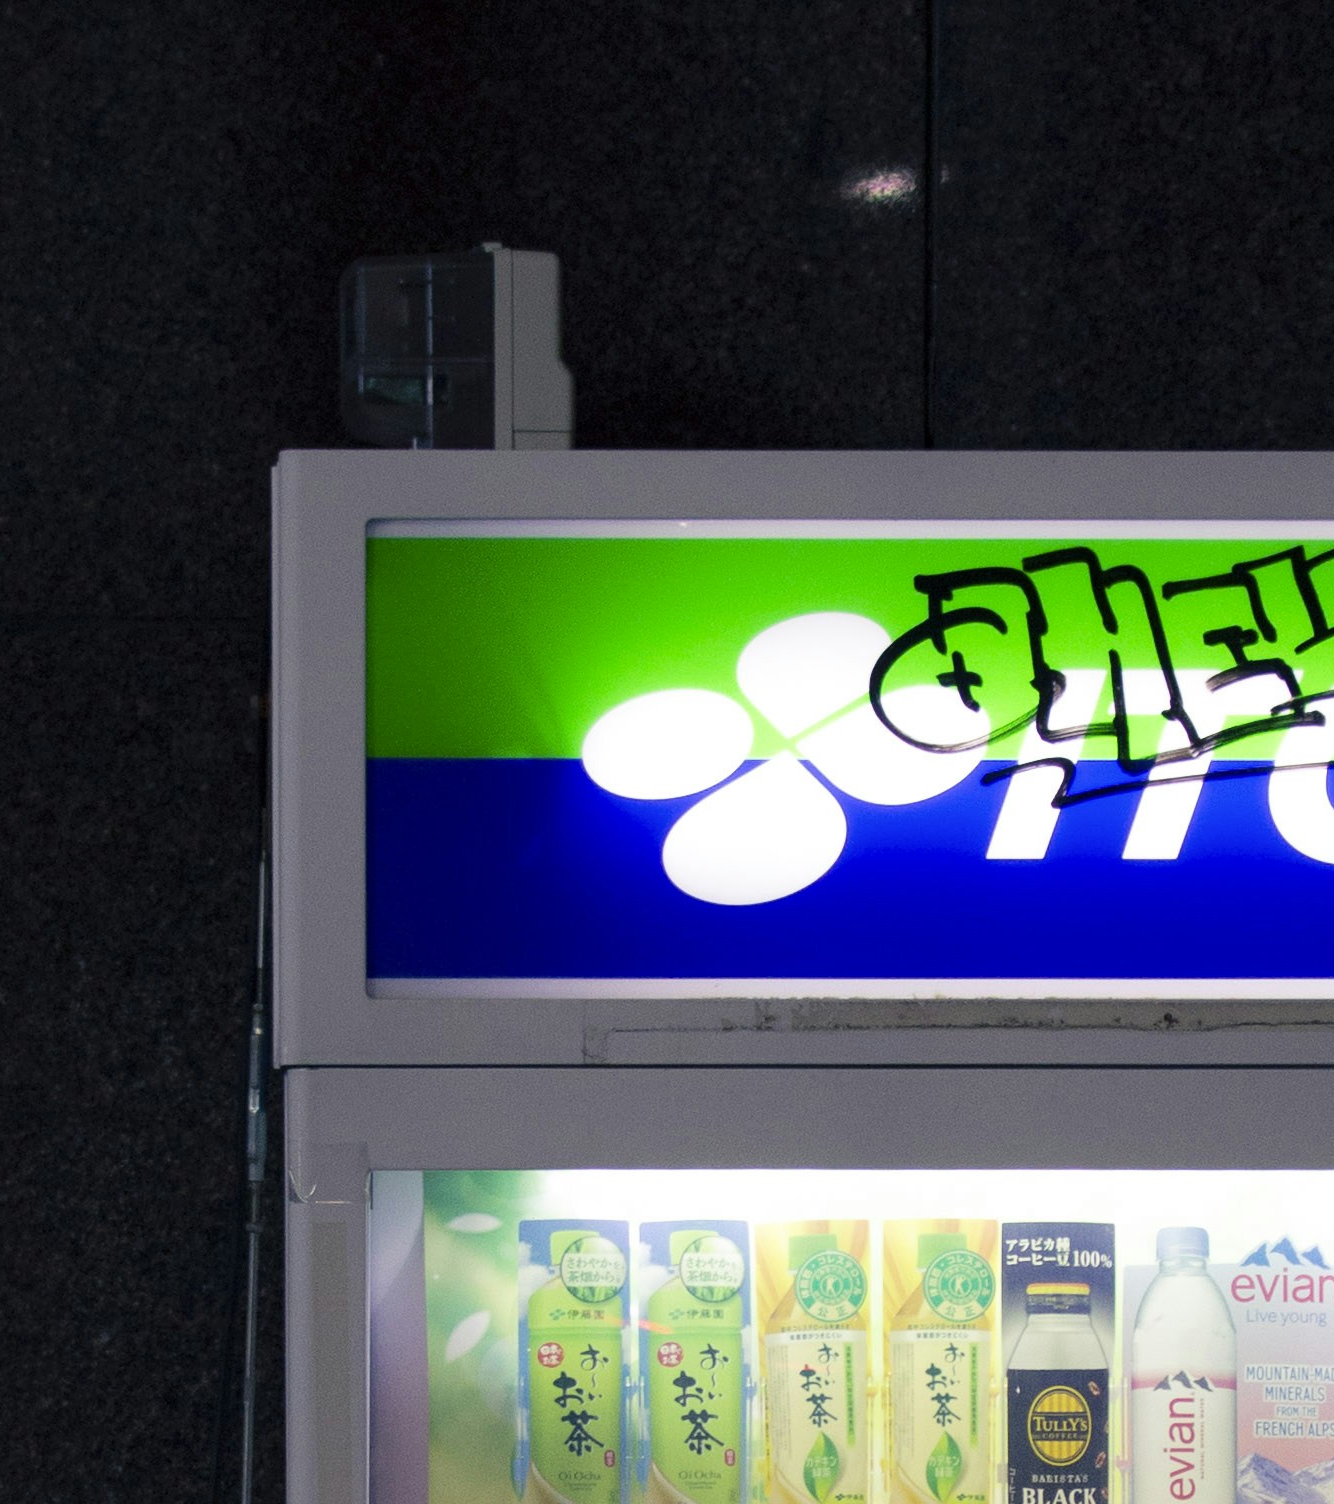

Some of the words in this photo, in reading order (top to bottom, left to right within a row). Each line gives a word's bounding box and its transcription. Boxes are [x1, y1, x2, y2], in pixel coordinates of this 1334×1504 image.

[1006, 1237, 1070, 1252] アラビカ種
[1006, 1252, 1070, 1266] コーヒー豆
[1074, 1250, 1112, 1268] 100%
[1246, 1310, 1276, 1323] Live
[1281, 1312, 1327, 1327] young
[1264, 1386, 1325, 1401] MINERALS
[1276, 1407, 1300, 1416] FROM
[1302, 1407, 1317, 1416] THE
[1255, 1422, 1303, 1436] FRENCH
[1163, 1397, 1195, 1500] evian
